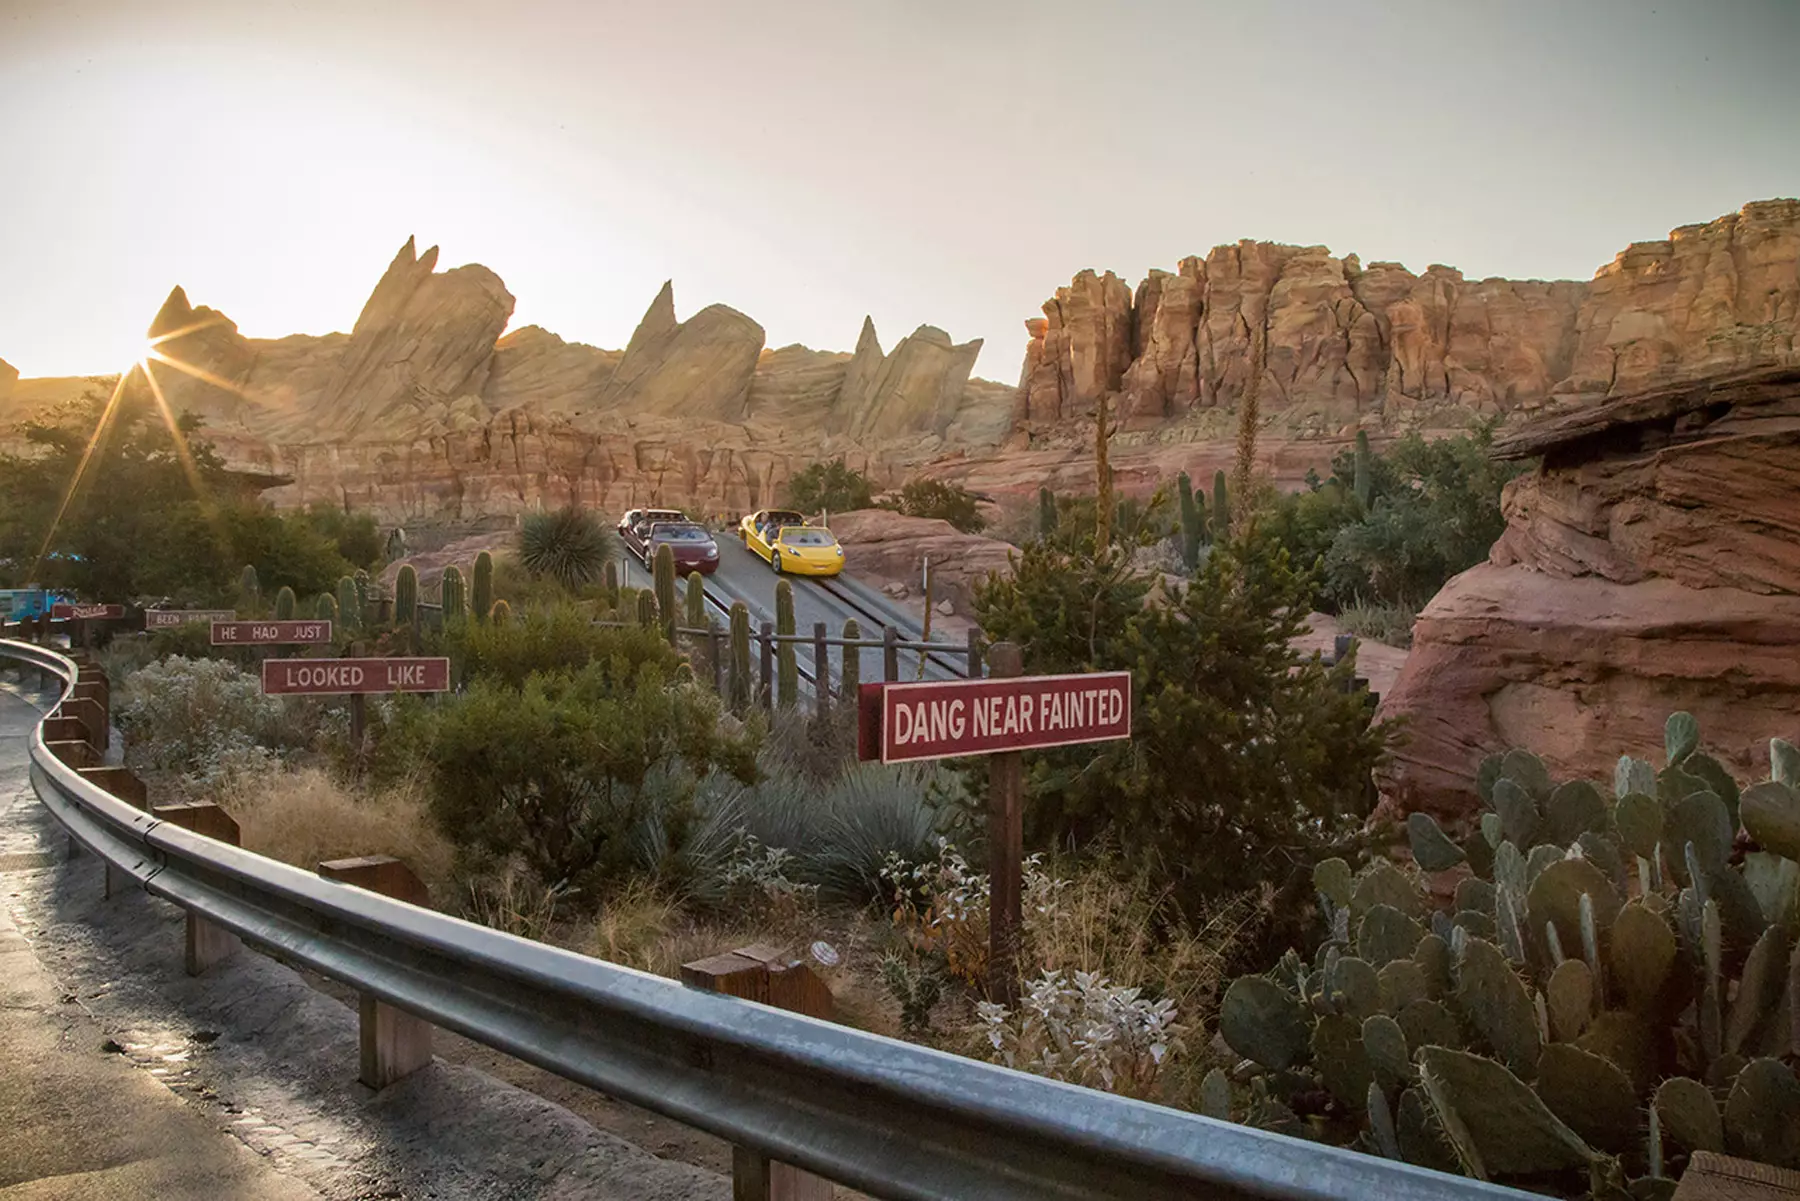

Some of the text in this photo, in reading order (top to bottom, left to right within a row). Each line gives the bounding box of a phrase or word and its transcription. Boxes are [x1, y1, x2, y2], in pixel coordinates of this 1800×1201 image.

[156, 614, 180, 625] BEEN
[221, 622, 322, 639] HE HAD JUST
[286, 665, 425, 687] LOOKED LIKE
[895, 688, 1123, 745] DANG NEAR FAINTED
